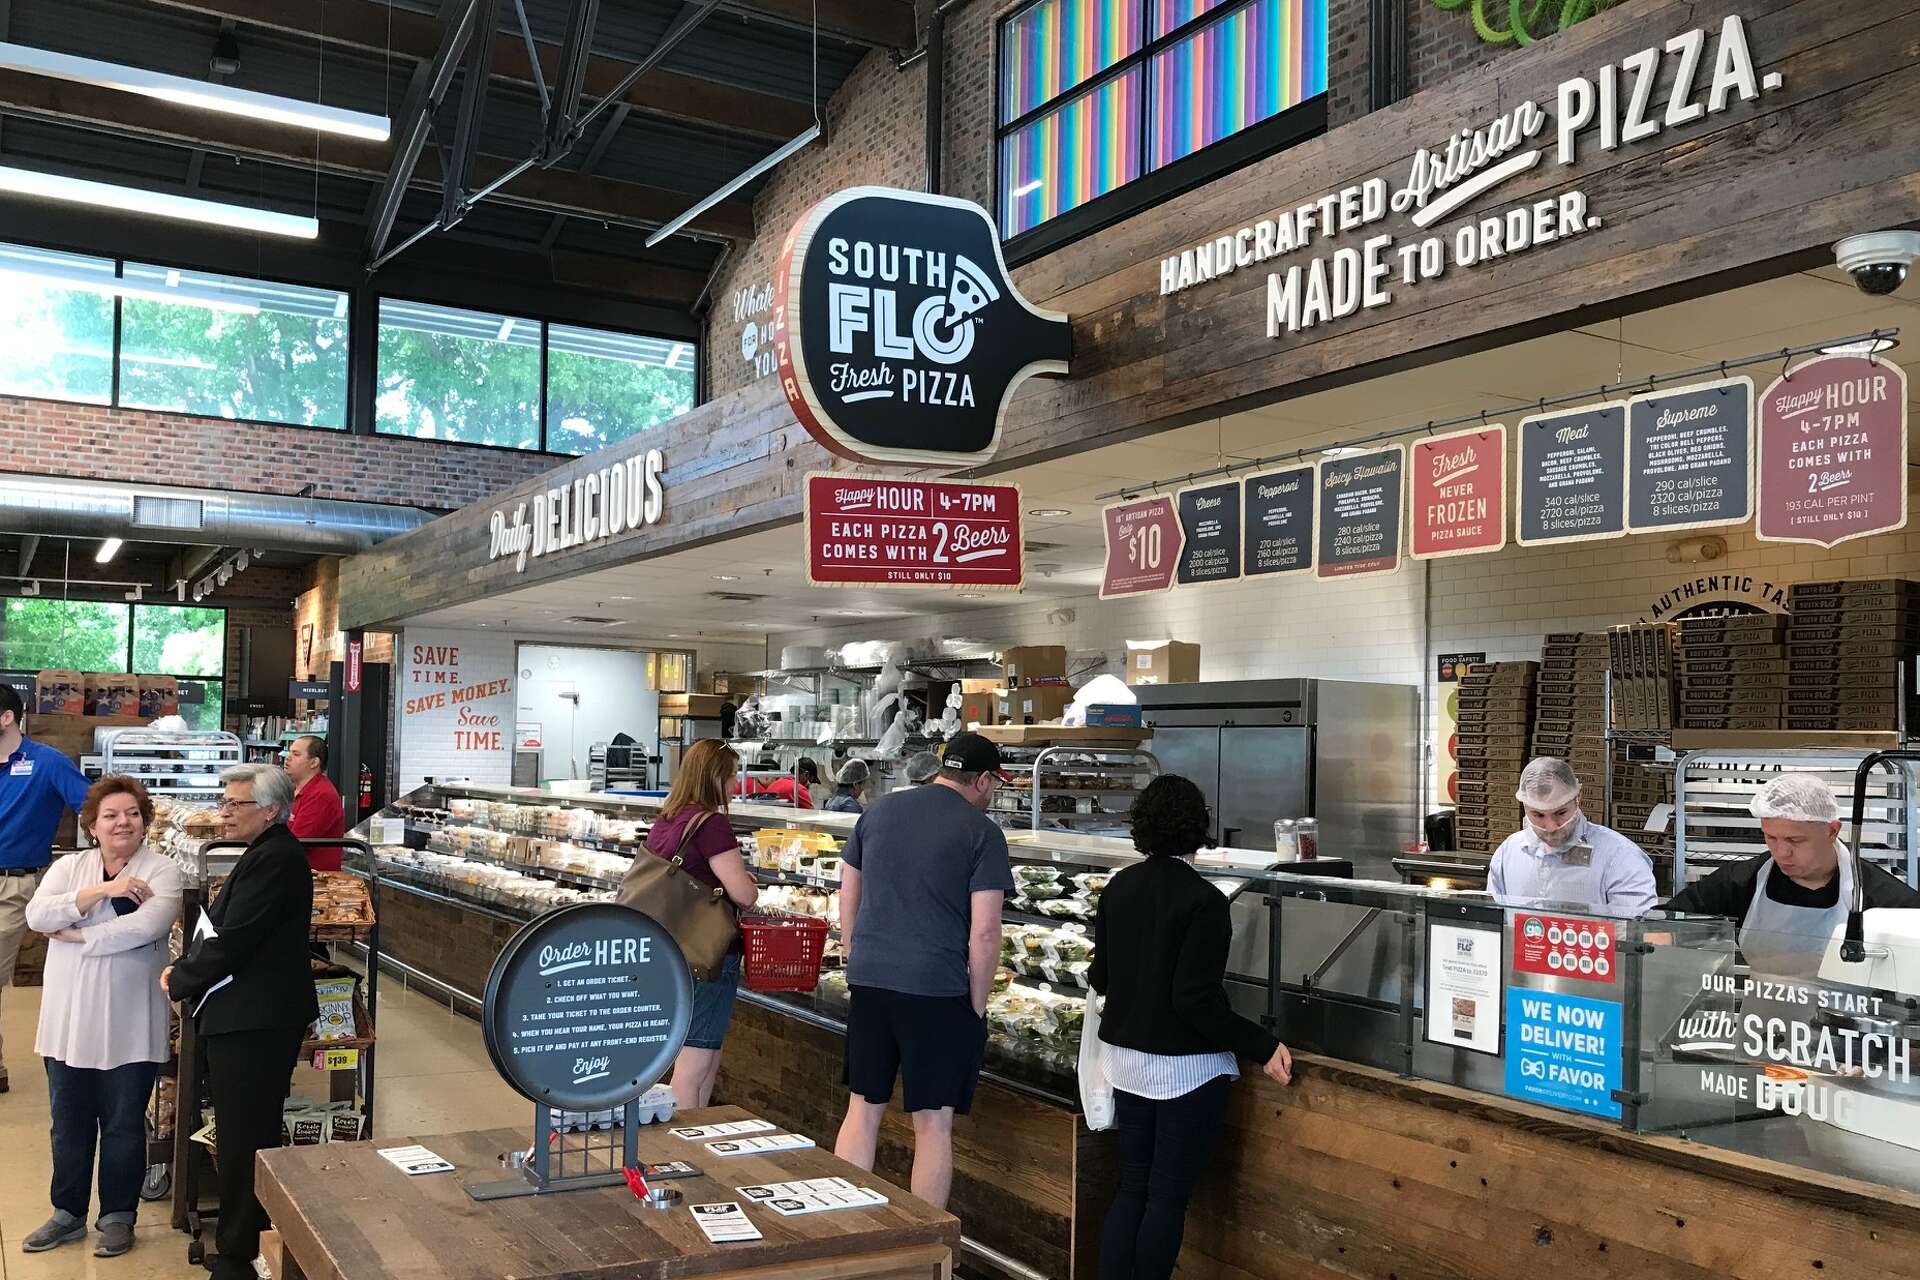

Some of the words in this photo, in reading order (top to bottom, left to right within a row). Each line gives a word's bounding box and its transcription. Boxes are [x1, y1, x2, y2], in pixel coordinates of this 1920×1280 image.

[1160, 177, 1388, 295] HANDCRAFTED
[1391, 100, 1546, 213] Artisan
[1557, 14, 1783, 165] PIZZA.
[828, 237, 947, 288] SOUTH
[1266, 234, 1392, 338] MADE
[1398, 237, 1445, 285] TO
[1455, 190, 1602, 267] ORDER.
[776, 237, 799, 401] PIZZA
[828, 282, 976, 364] FLO
[830, 362, 894, 393] Fresh
[903, 368, 976, 408] PIZZA
[1776, 387, 1824, 413] Happy
[1826, 376, 1887, 409] HOUR
[1656, 404, 1718, 431] Supreme
[1801, 412, 1860, 434] 4-7PM
[1556, 424, 1589, 444] Meat
[1792, 439, 1824, 453] EACH
[1830, 432, 1868, 448] PIZZA
[1432, 446, 1477, 477] Fresh
[1789, 455, 1831, 469] COMES
[1837, 449, 1872, 464] WITH
[1258, 479, 1300, 499] Pepperoni
[1325, 472, 1352, 489] Spicy
[1656, 480, 1674, 492] 290
[1678, 476, 1718, 489] cal/slice
[1809, 473, 1817, 493] 2
[1818, 469, 1852, 486] Beers
[835, 488, 875, 504] Happy
[877, 487, 924, 510] HOUR
[939, 492, 995, 512] 4-7PM
[1440, 483, 1473, 499] NEVER
[1545, 496, 1562, 507] 340
[1564, 492, 1600, 505] cal/slice
[1651, 492, 1675, 504] 2320
[1678, 488, 1723, 501] cal/pizza
[489, 503, 532, 573] Daily
[532, 449, 664, 557] DELICIOUS
[1196, 497, 1221, 510] Cheese
[1540, 508, 1562, 519] 2720
[1564, 504, 1604, 516] cal/pizza
[1653, 506, 1659, 516] 8
[1663, 501, 1720, 515] slices/pizza
[1786, 501, 1800, 511] 193
[1804, 498, 1824, 509] CAL
[1828, 495, 1848, 507] PER
[1851, 492, 1875, 504] PINT
[1149, 507, 1164, 517] PIZZA
[1428, 498, 1487, 526] FROZEN
[1797, 514, 1820, 524] STILL
[1823, 512, 1844, 522] ONLY
[1847, 510, 1861, 520] $10
[831, 522, 872, 538] EACH
[881, 524, 926, 539] PIZZA
[1338, 526, 1350, 536] 280
[1352, 523, 1379, 534] cal/slice
[1431, 530, 1454, 540] PIZZA
[1456, 526, 1482, 536] SAUCE
[1543, 520, 1548, 530] 8
[1551, 516, 1601, 530] slices/pizza
[933, 522, 948, 563] 2
[950, 524, 1010, 552] Beers
[1128, 524, 1161, 570] $10
[1353, 533, 1383, 544] cal/pizza
[823, 544, 877, 559] COMES
[886, 546, 926, 561] WITH
[1336, 547, 1340, 556] 8
[1342, 544, 1380, 555] slices/pizza
[887, 571, 911, 580] STILL
[915, 572, 935, 580] ONLY
[1651, 576, 1752, 618] AUTHENTIC
[413, 645, 459, 666] SAVE
[413, 671, 462, 684] TIME.
[406, 693, 445, 715] SAVE
[451, 678, 511, 704] MONEY.
[458, 706, 500, 727] Save
[454, 731, 504, 750] TIME.
[539, 942, 592, 967] Order
[595, 937, 651, 965] HERE
[1702, 973, 1736, 994] OUR
[1744, 979, 1809, 1005] PIZZAS
[1818, 990, 1883, 1016] START
[319, 1002, 350, 1015] SKINNY
[634, 1004, 662, 1012] COUNTER.
[1522, 999, 1552, 1021] WE
[1558, 1005, 1605, 1031] NOW
[650, 1019, 670, 1027] READY.
[603, 1037, 637, 1046] FRONT-END
[639, 1034, 669, 1043] REGISTER.
[1521, 1023, 1605, 1056] DELIVER!
[1678, 1010, 1736, 1039] with
[1743, 1014, 1910, 1084] SCRATCH
[573, 1056, 611, 1075] Enjoy
[1552, 1052, 1572, 1062] WITH
[1549, 1064, 1605, 1091] FAVOR
[1701, 1070, 1748, 1100] MADE
